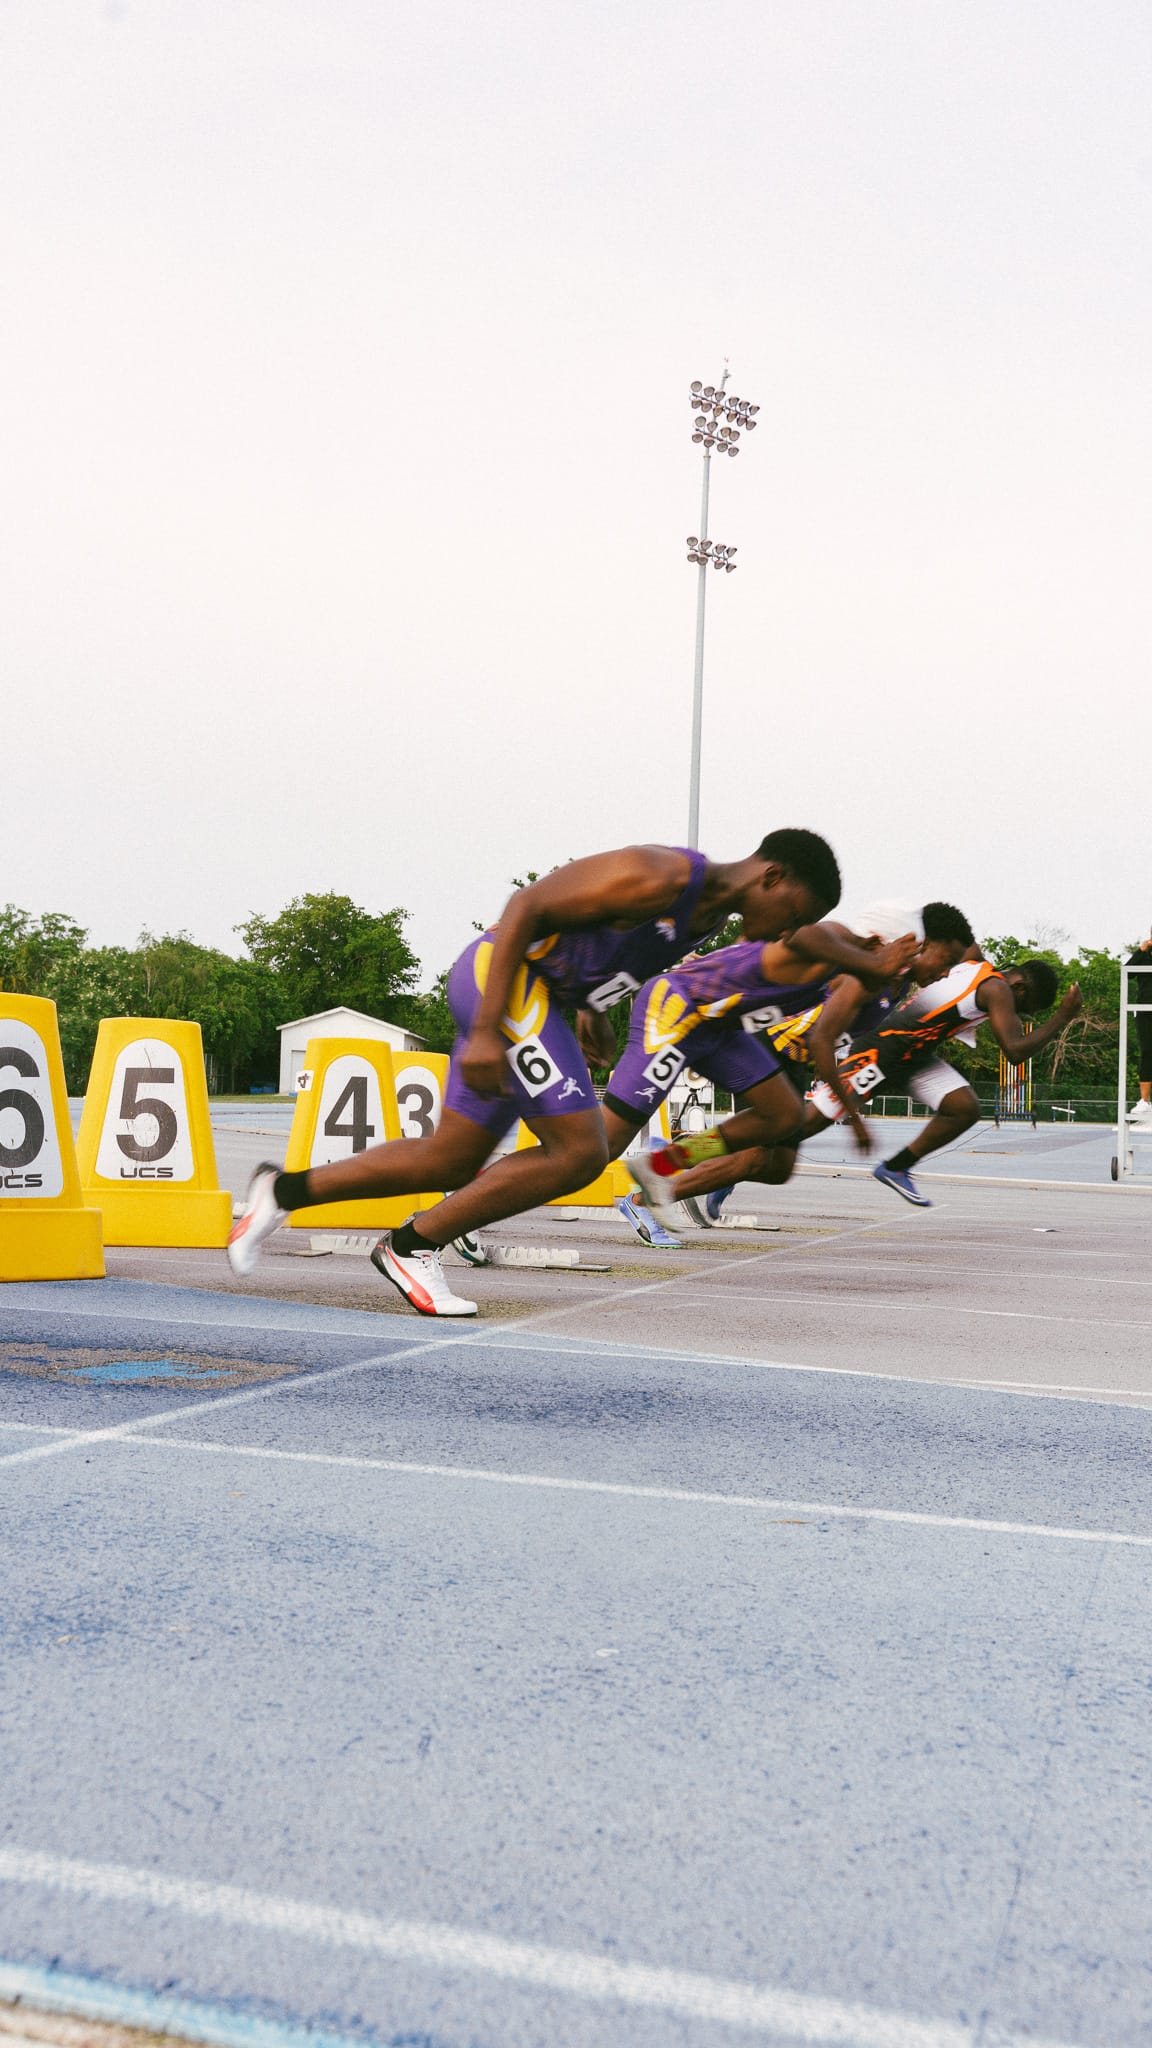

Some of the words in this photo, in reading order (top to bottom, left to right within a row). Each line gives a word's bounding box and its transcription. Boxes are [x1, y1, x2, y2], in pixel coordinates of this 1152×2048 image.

[516, 1045, 552, 1086] 6
[652, 1051, 681, 1082] 5
[856, 1068, 877, 1088] 3
[0, 1046, 45, 1169] 6
[116, 1067, 178, 1163] 5
[324, 1076, 375, 1154] 4
[396, 1083, 435, 1139] 3
[0, 1173, 43, 1189] CS
[120, 1167, 174, 1179] UCS
